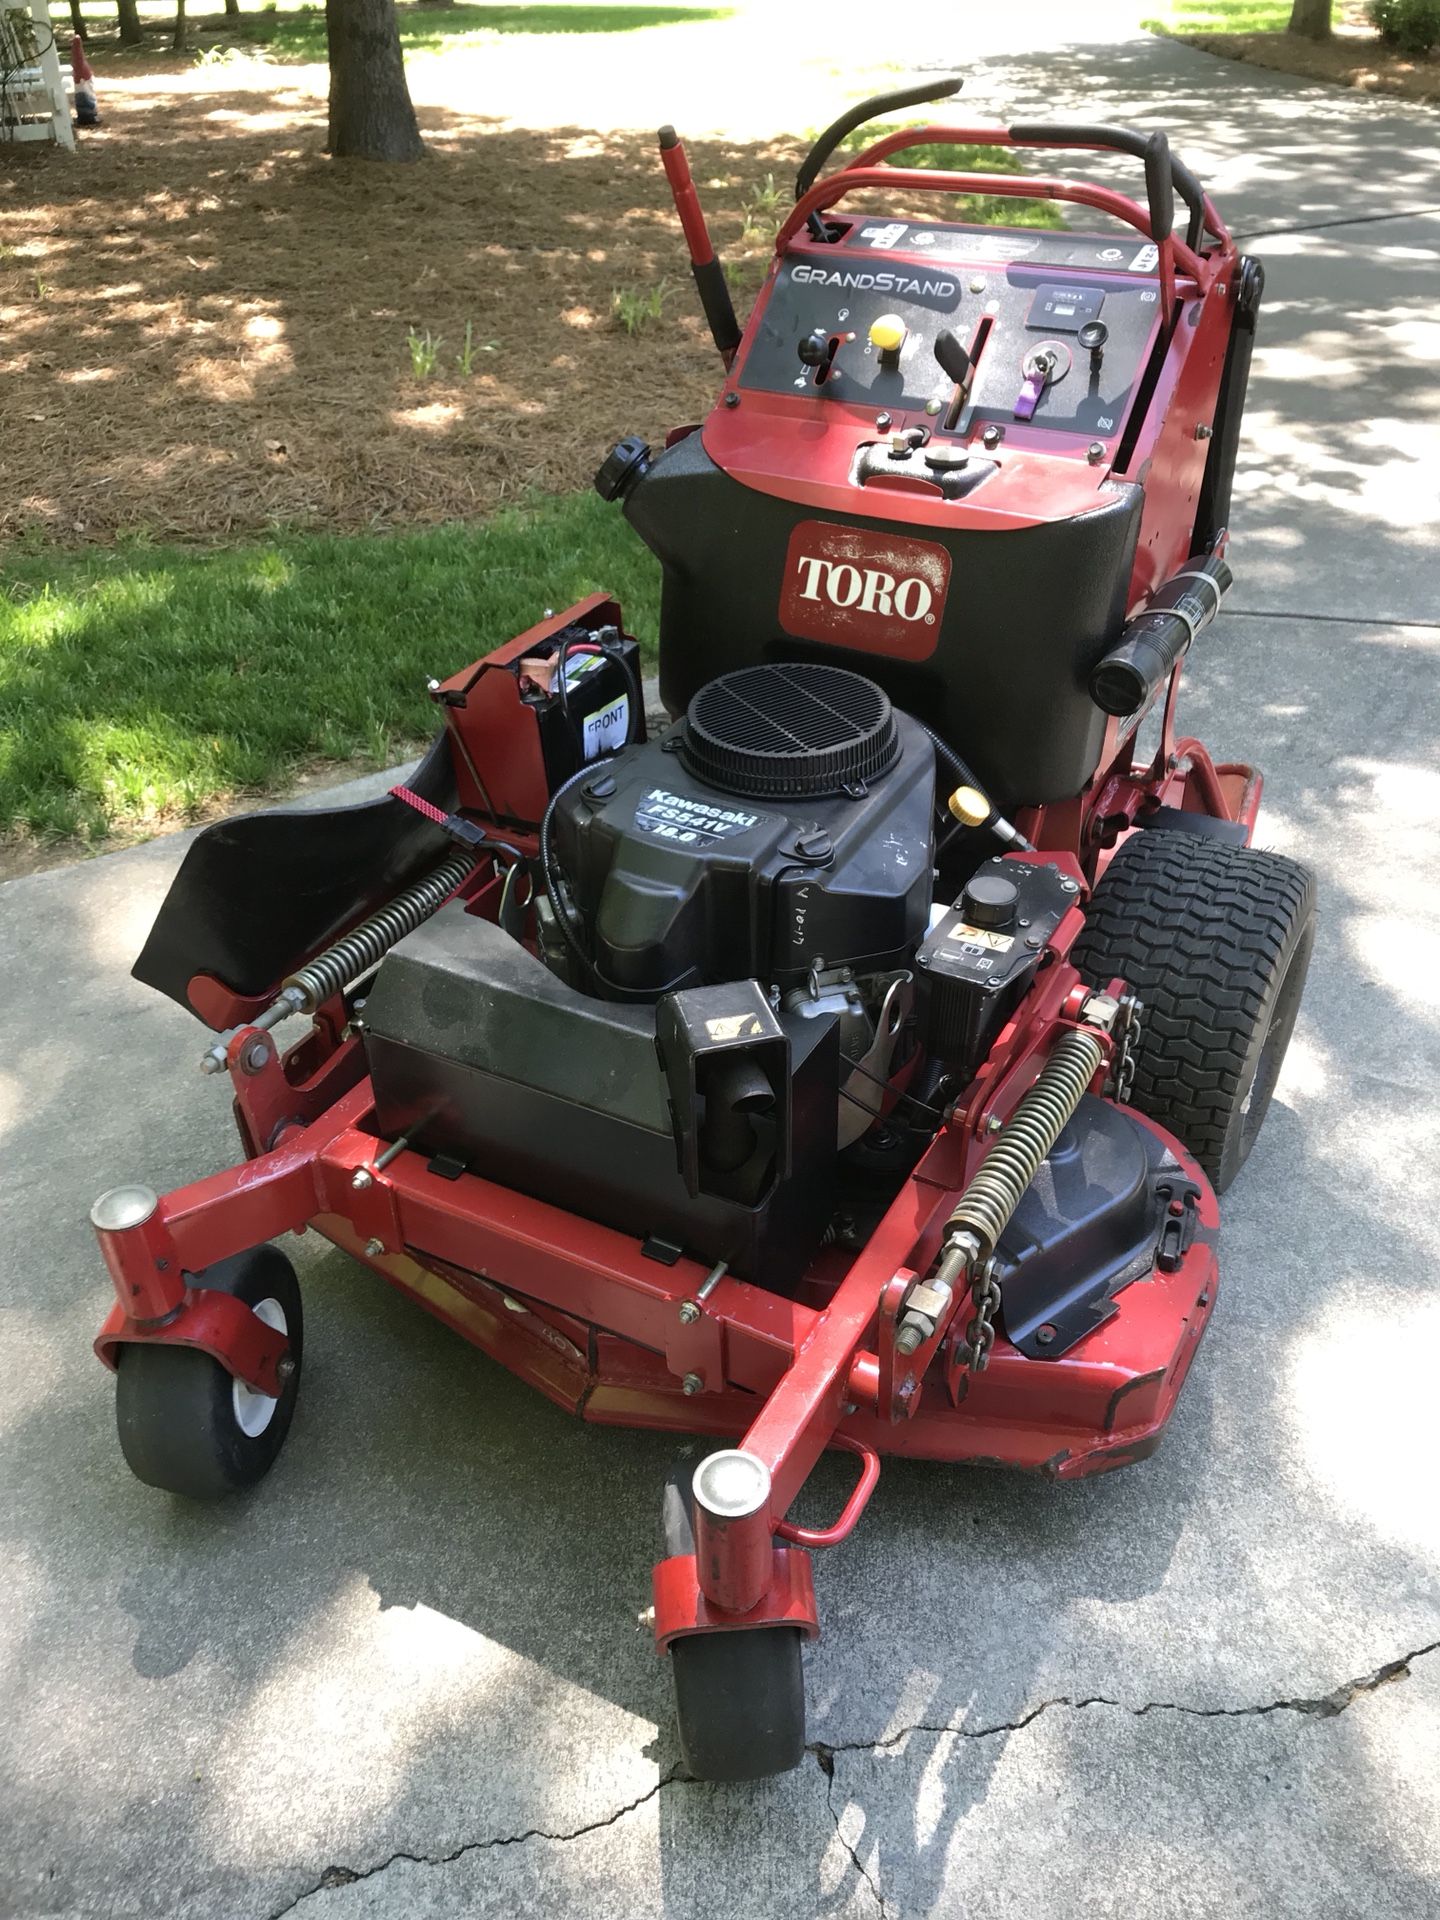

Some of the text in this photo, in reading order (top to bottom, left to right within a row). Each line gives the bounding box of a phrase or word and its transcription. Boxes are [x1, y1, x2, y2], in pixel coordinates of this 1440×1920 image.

[588, 704, 625, 733] FRONT
[647, 789, 758, 827] Kawasaki
[647, 804, 733, 833] FS541V
[652, 823, 698, 842] 18.0
